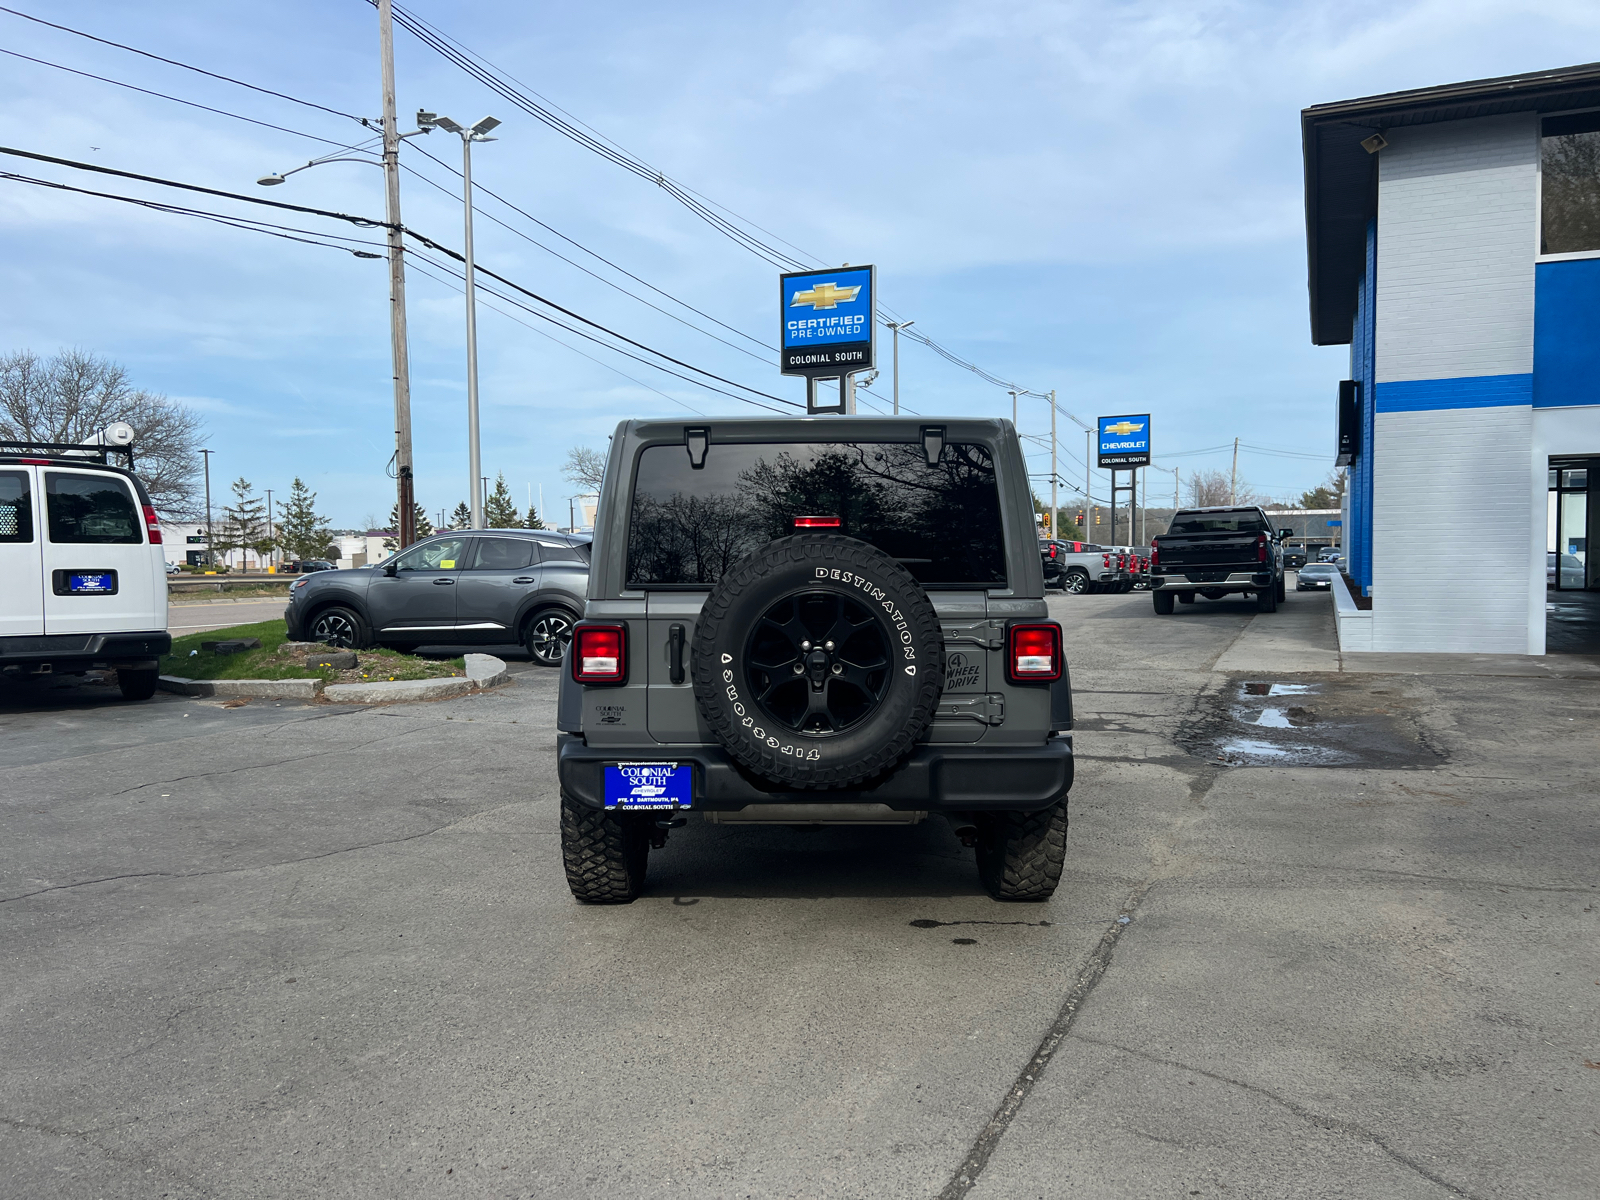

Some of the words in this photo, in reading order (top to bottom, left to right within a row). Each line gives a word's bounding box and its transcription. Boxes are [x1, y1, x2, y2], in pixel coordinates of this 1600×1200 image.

[787, 314, 864, 329] CERTIFIED
[791, 325, 861, 339] PRE-OWNED
[790, 354, 830, 364] COLONIAL
[835, 351, 863, 362] SOUTH
[1102, 441, 1146, 449] CHEVROLET
[815, 567, 916, 660] DESTINATION
[951, 654, 962, 667] 4
[946, 665, 980, 680] WHEEL
[947, 675, 980, 690] DRIVE
[621, 768, 675, 777] COLONIAL
[629, 777, 666, 786] SOUTH
